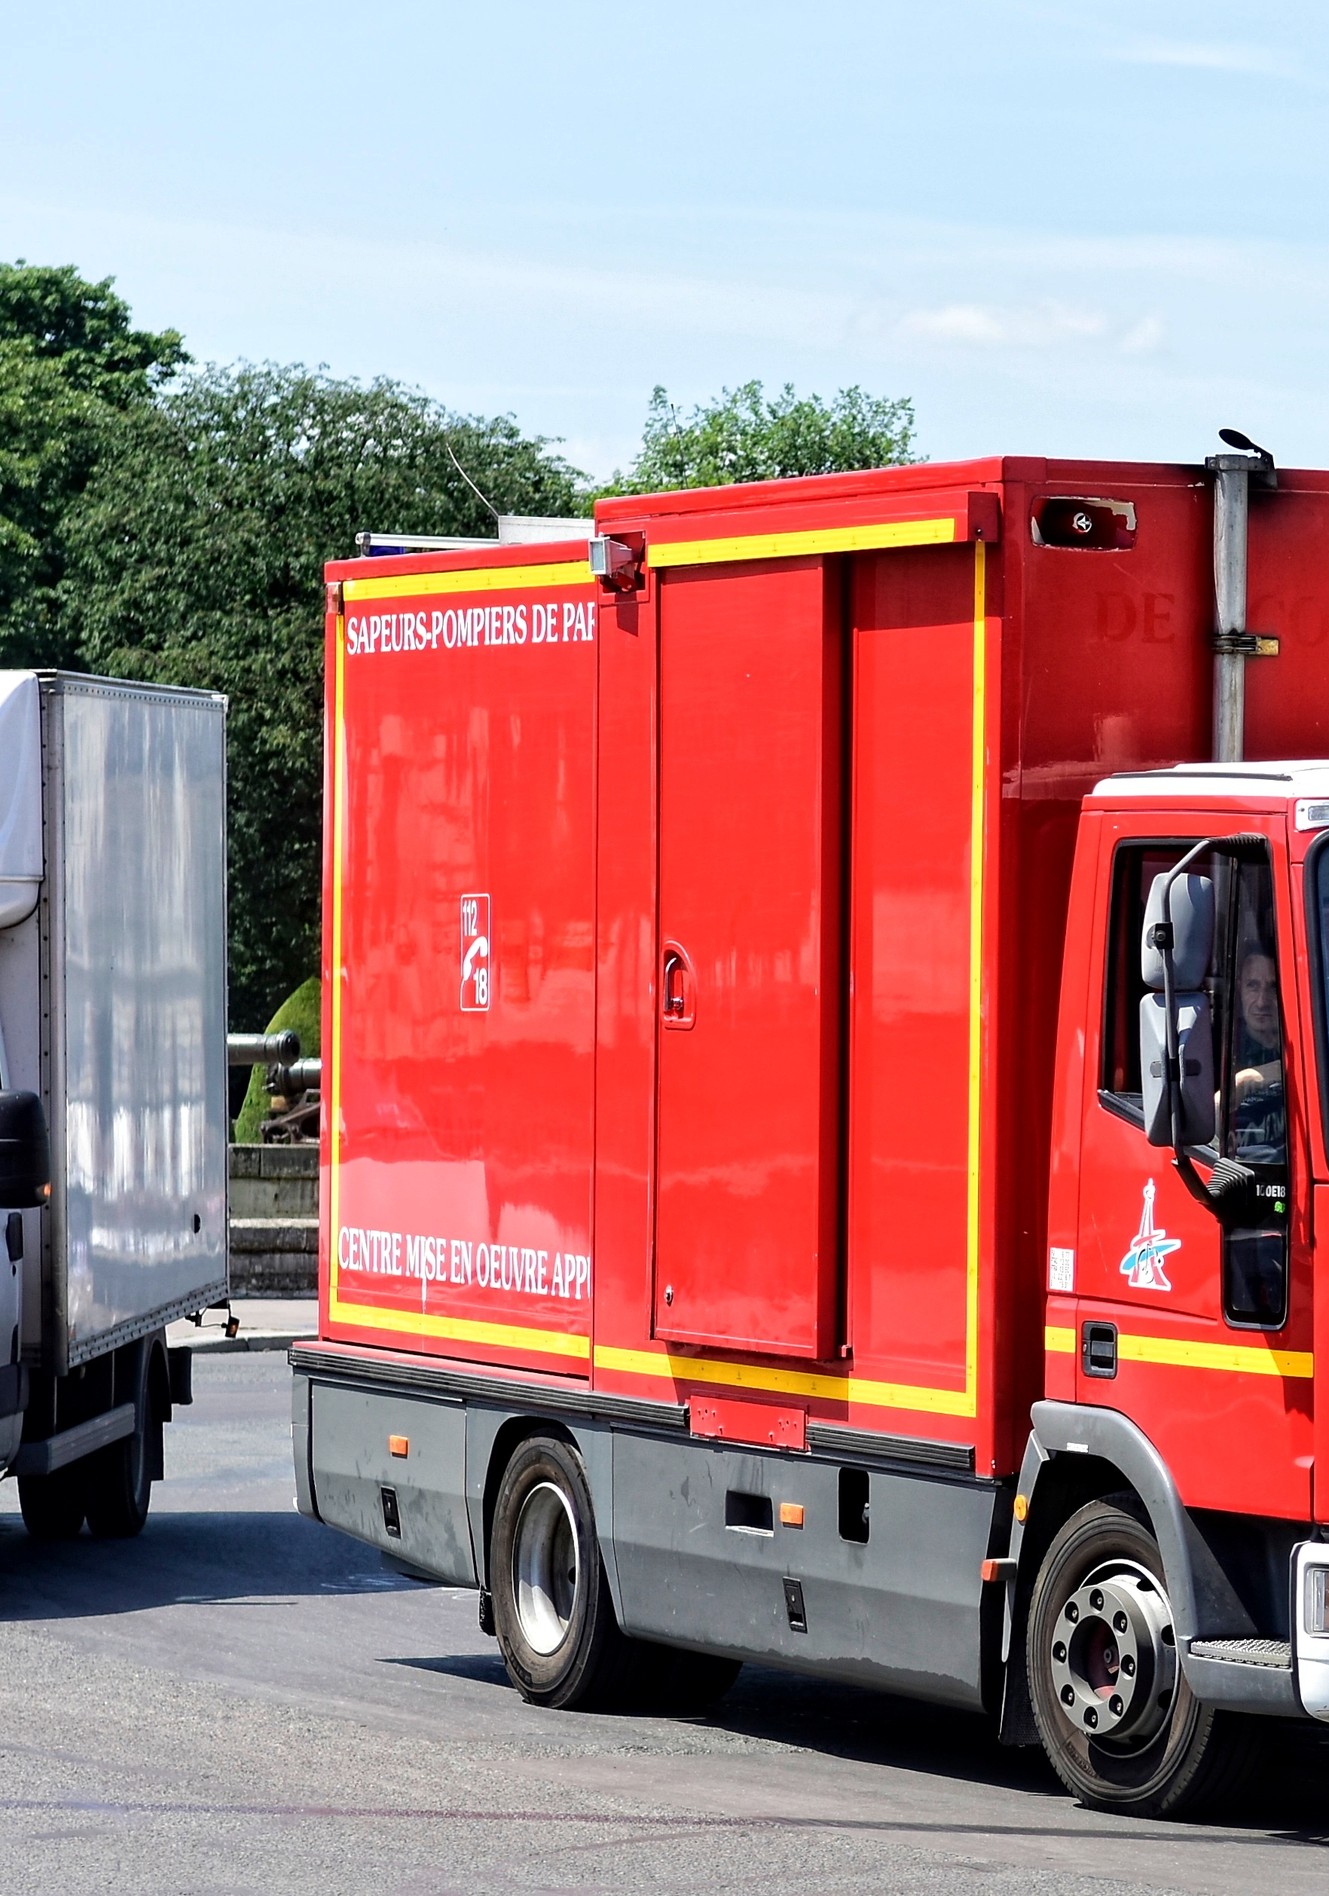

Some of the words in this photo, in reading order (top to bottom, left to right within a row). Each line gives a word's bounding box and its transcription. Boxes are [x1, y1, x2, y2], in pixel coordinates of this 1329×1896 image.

[346, 603, 528, 655] SAPEURS-POMPIERS
[531, 603, 558, 643] DE
[462, 899, 478, 936] 112
[473, 967, 488, 1005] 18
[337, 1226, 402, 1275] CENTRE
[405, 1234, 447, 1281] MISE
[450, 1239, 473, 1286] EN
[476, 1242, 549, 1295] OEUVRE
[551, 1252, 592, 1301] APP
